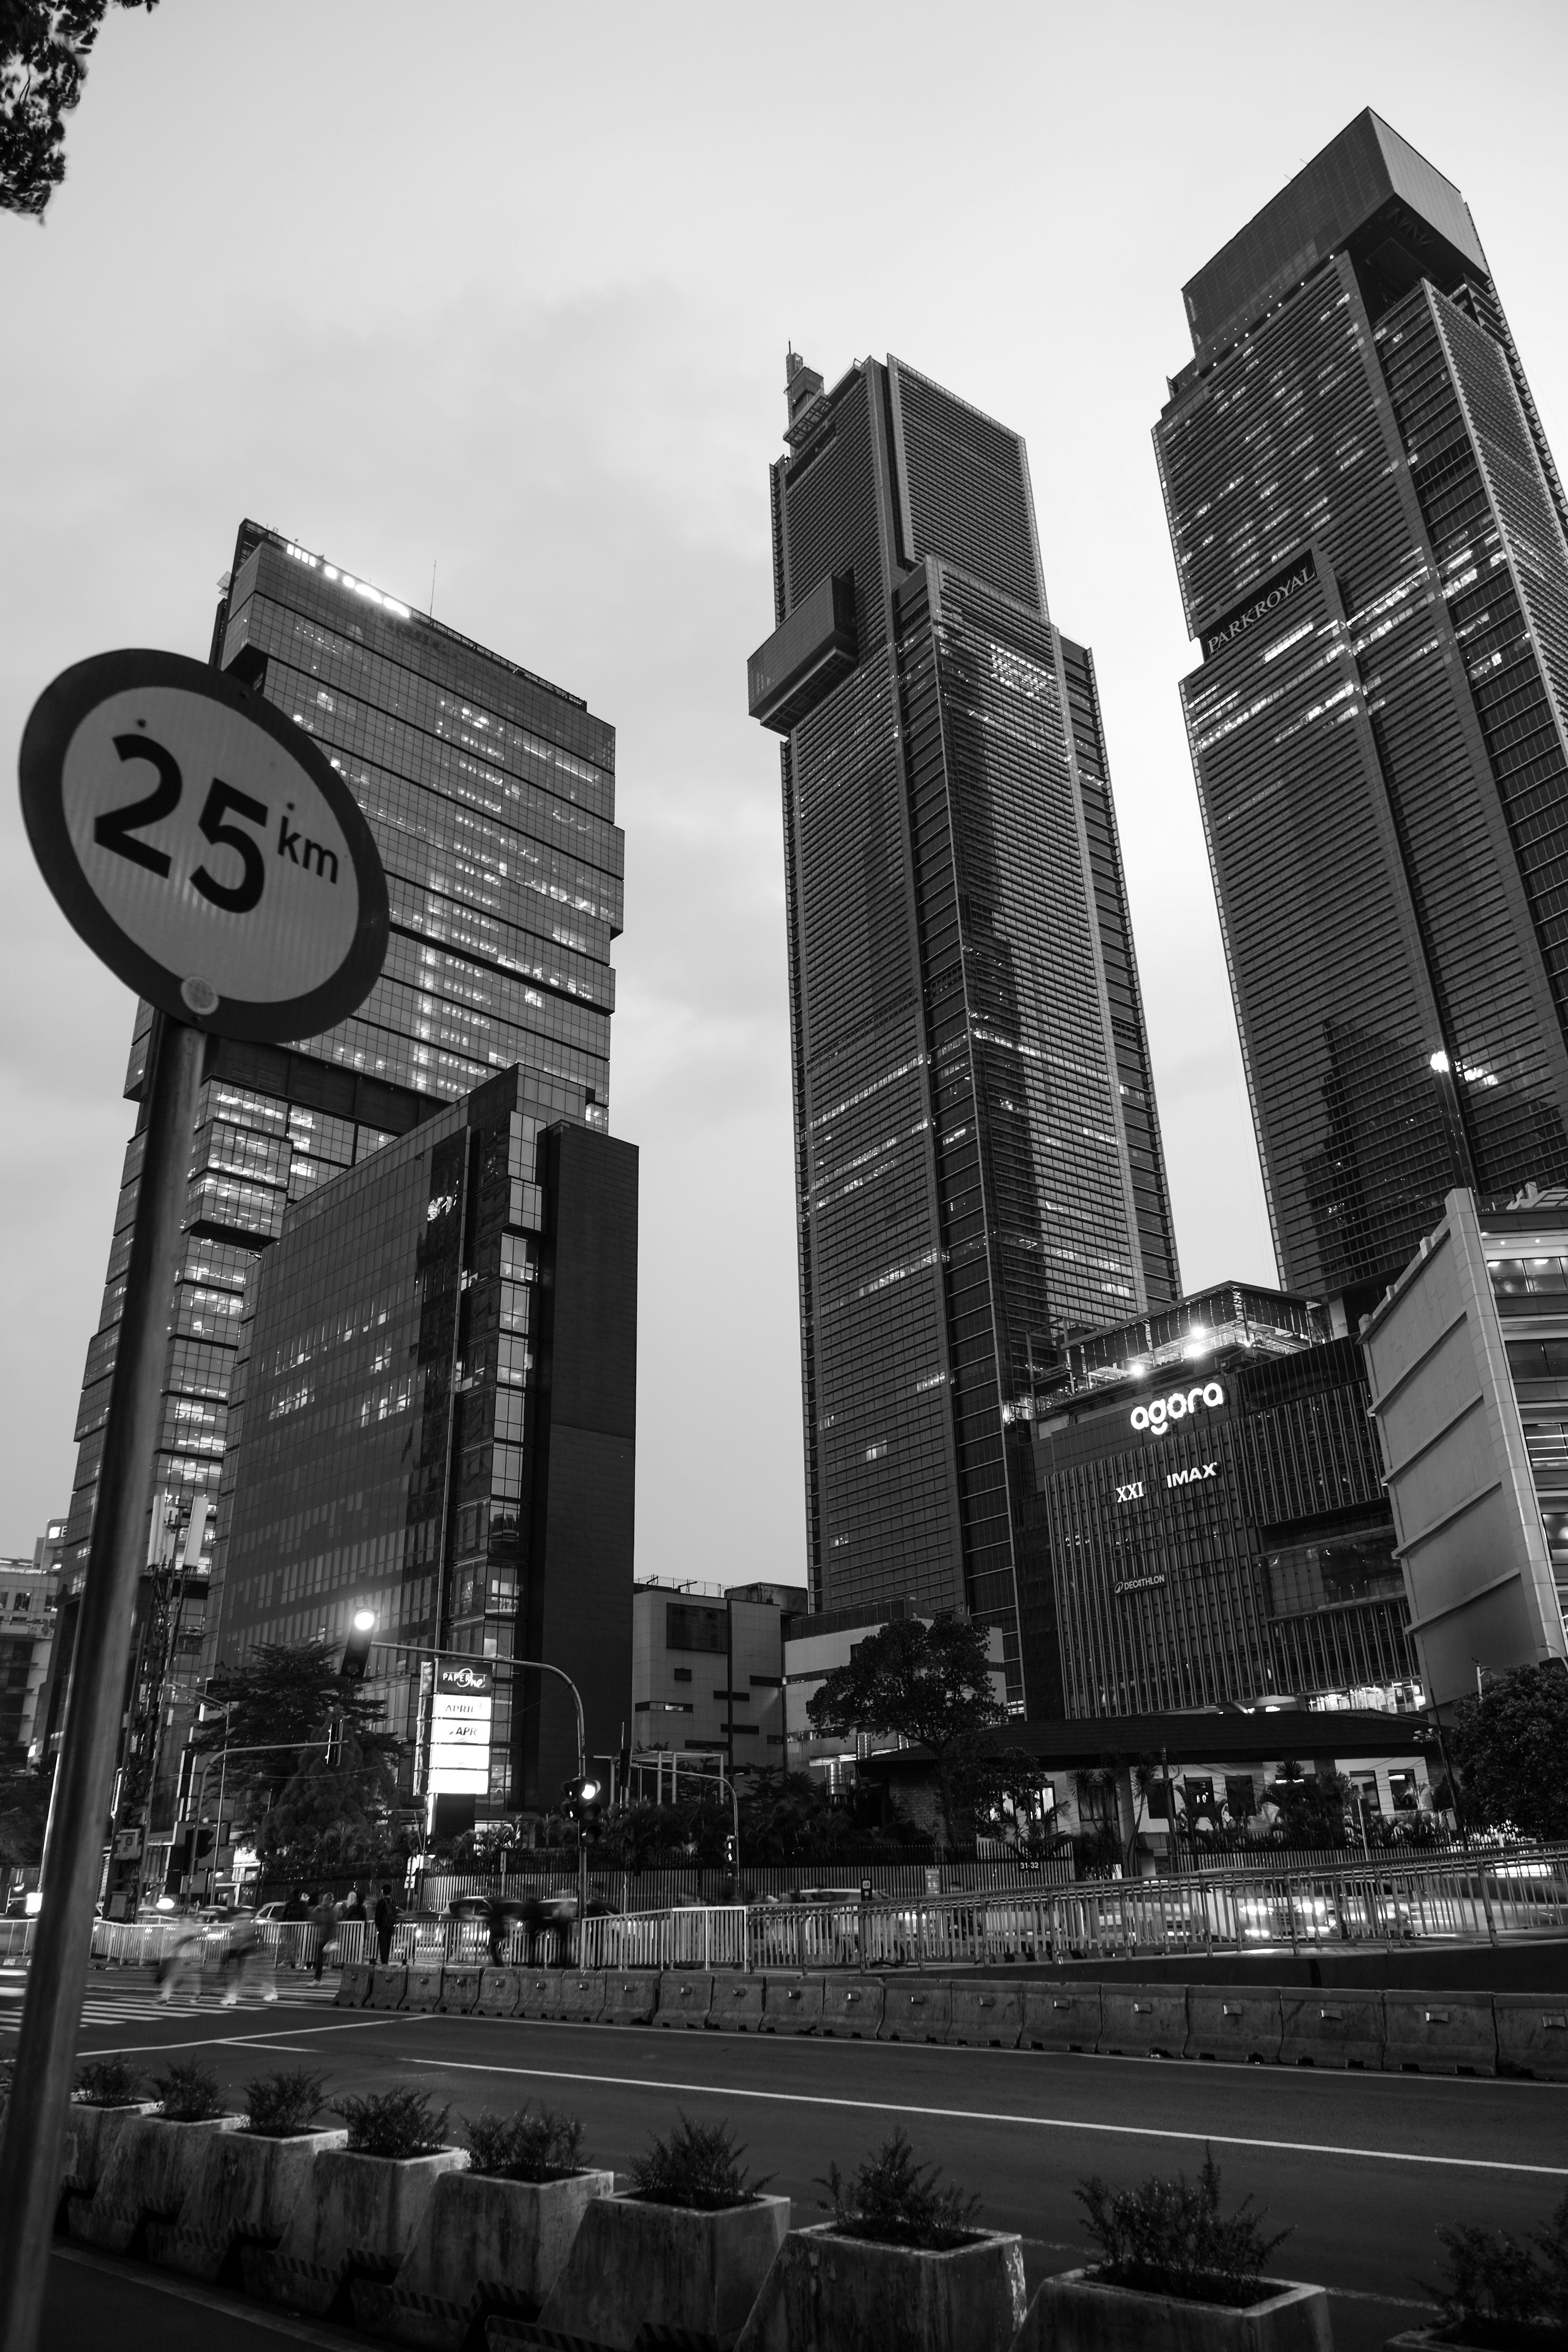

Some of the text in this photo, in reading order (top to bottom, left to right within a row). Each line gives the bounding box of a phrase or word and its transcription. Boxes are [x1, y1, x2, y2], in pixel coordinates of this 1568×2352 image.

[1207, 567, 1316, 654] PARKROYAL
[94, 733, 339, 914] 25 km
[1130, 1383, 1223, 1435] agora
[1116, 1481, 1144, 1503] XXI
[1167, 1462, 1217, 1488] IMAX
[1124, 1574, 1165, 1591] DECATHLON
